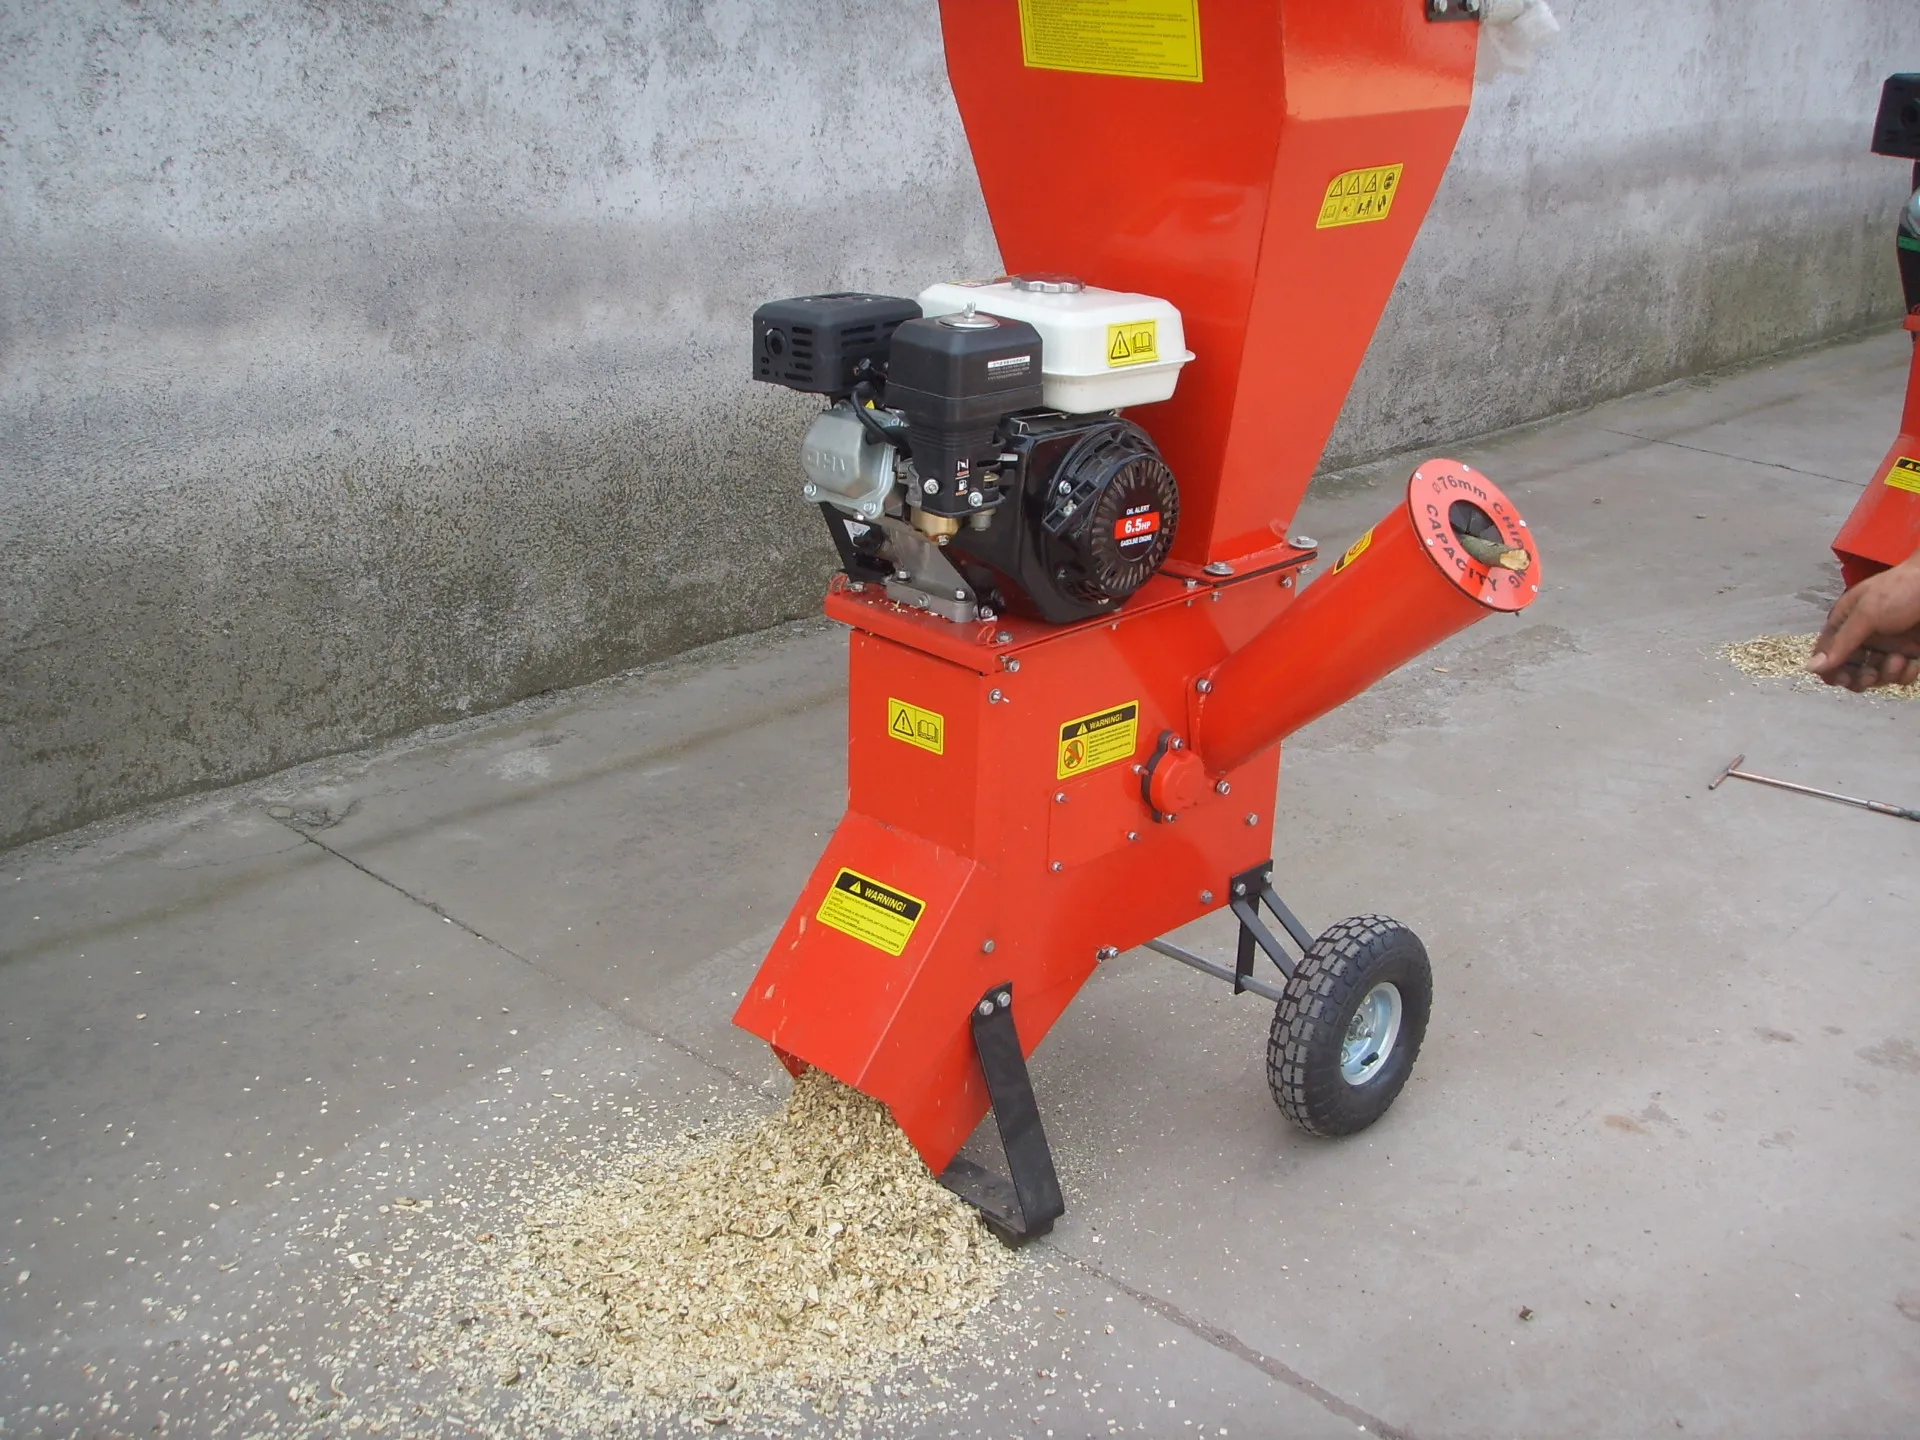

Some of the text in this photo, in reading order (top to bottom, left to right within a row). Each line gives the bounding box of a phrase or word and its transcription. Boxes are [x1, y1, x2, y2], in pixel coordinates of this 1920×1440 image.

[1427, 504, 1498, 591] CAPACITY
[1493, 502, 1526, 588] CHIPNG
[1089, 713, 1123, 730] WARNING!
[864, 887, 907, 913] WARNING!
